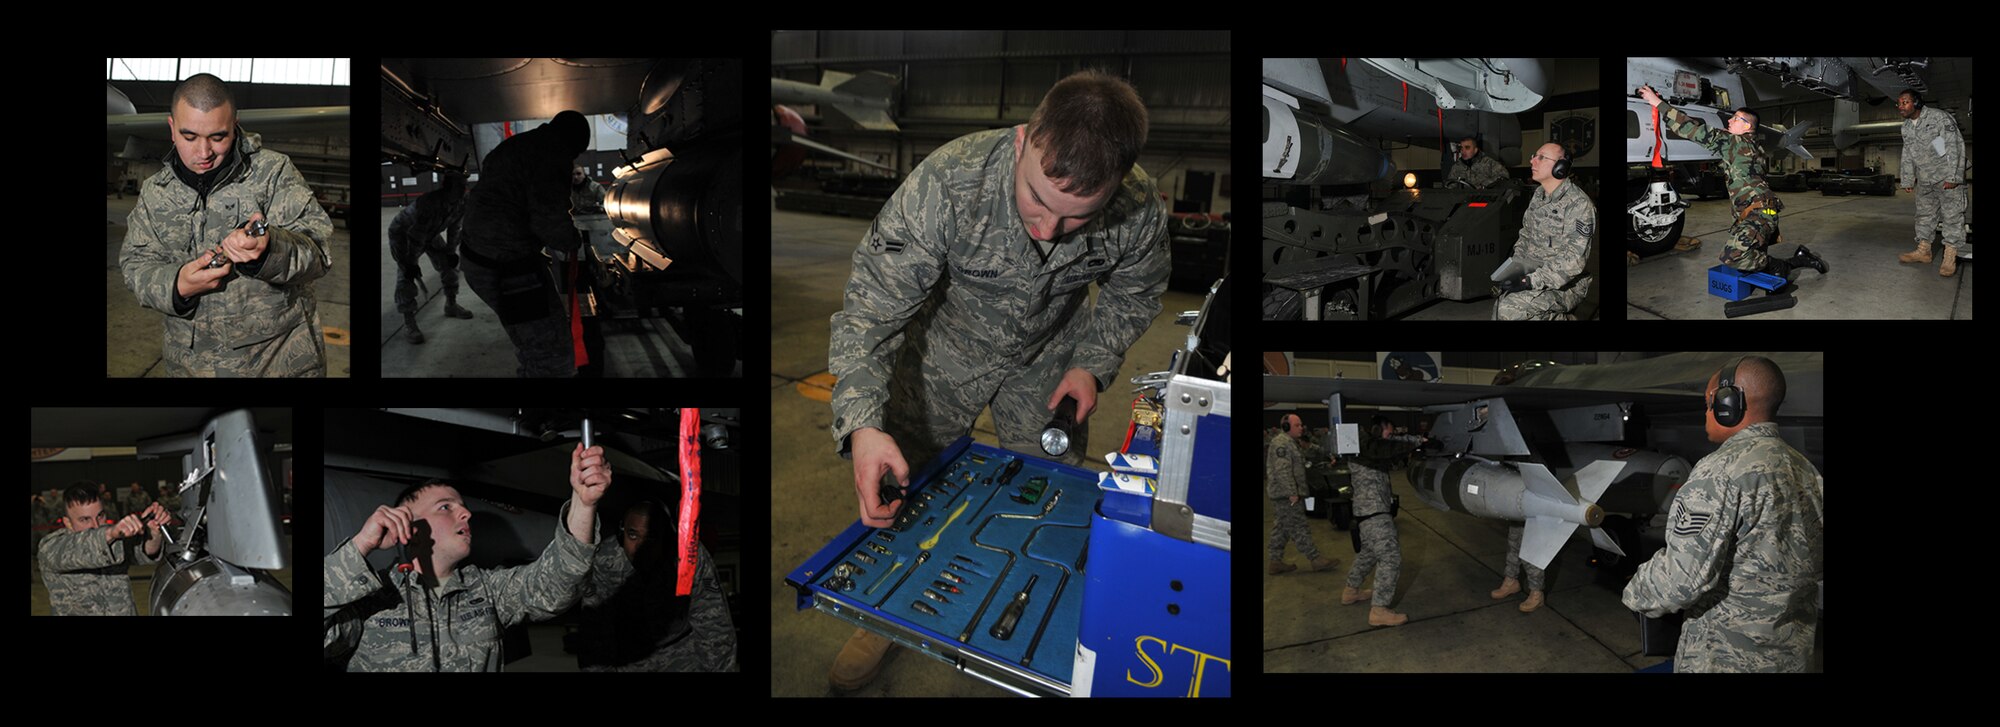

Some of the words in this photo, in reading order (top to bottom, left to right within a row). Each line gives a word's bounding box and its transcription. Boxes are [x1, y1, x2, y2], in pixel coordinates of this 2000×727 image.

[957, 266, 998, 279] BROWN
[1711, 279, 1733, 294] SLUGS
[1126, 635, 1231, 698] ST
